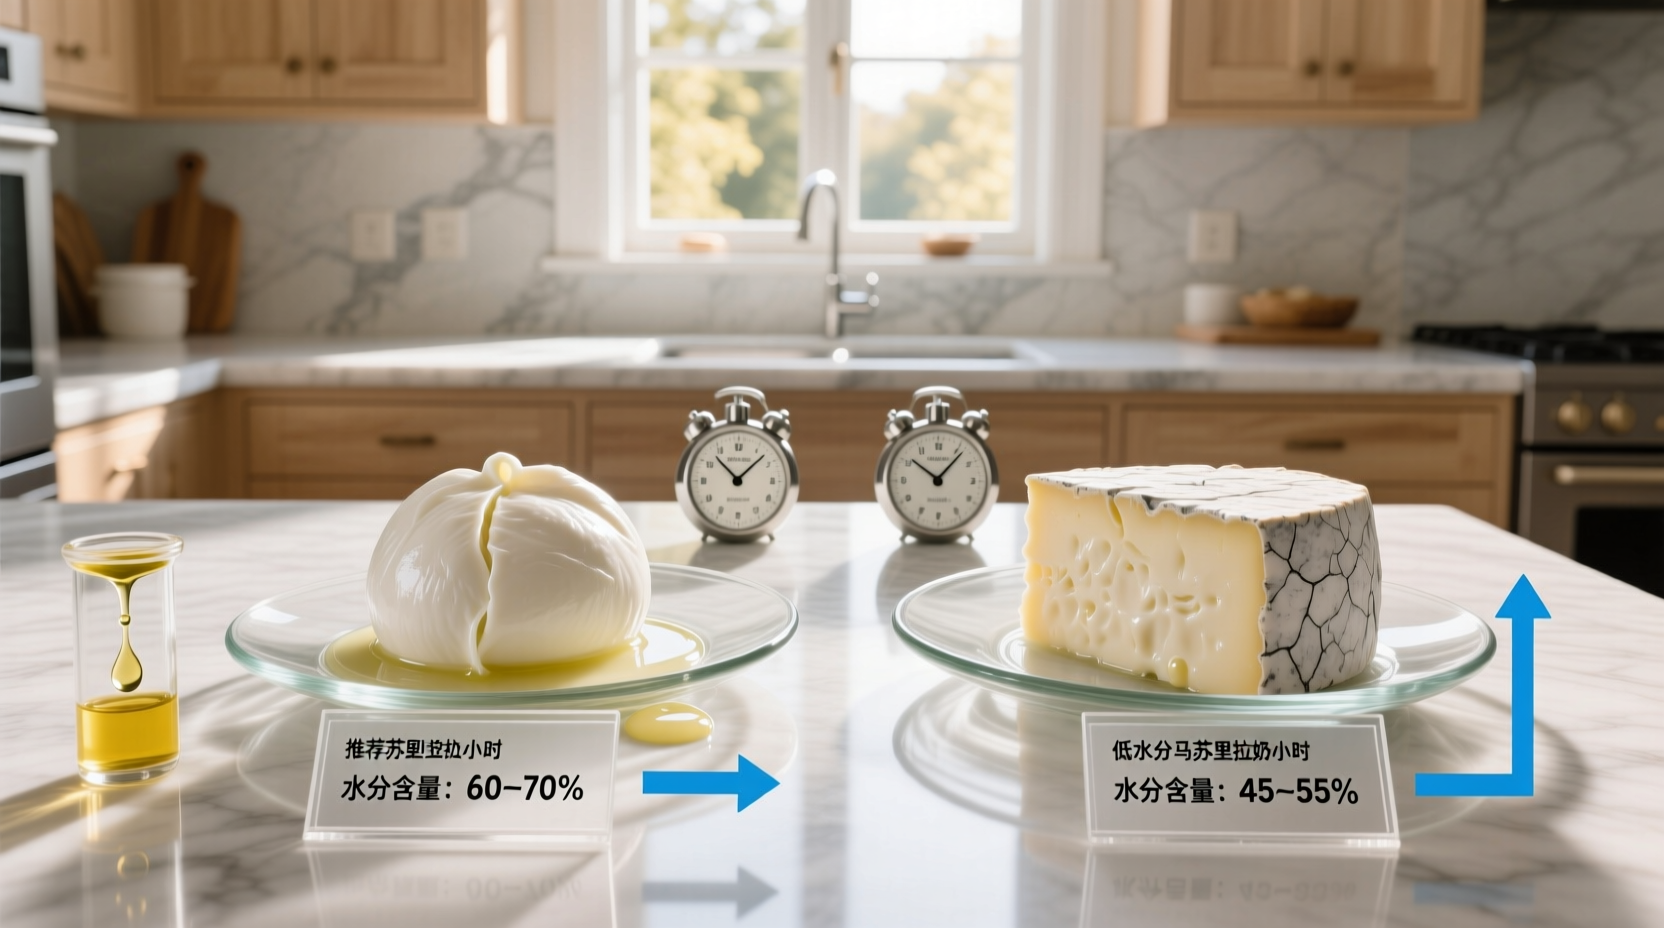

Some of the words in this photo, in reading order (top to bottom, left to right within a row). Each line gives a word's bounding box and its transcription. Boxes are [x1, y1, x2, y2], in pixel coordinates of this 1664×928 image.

[1112, 739, 1311, 762] 低水分马苏里拉奶小时
